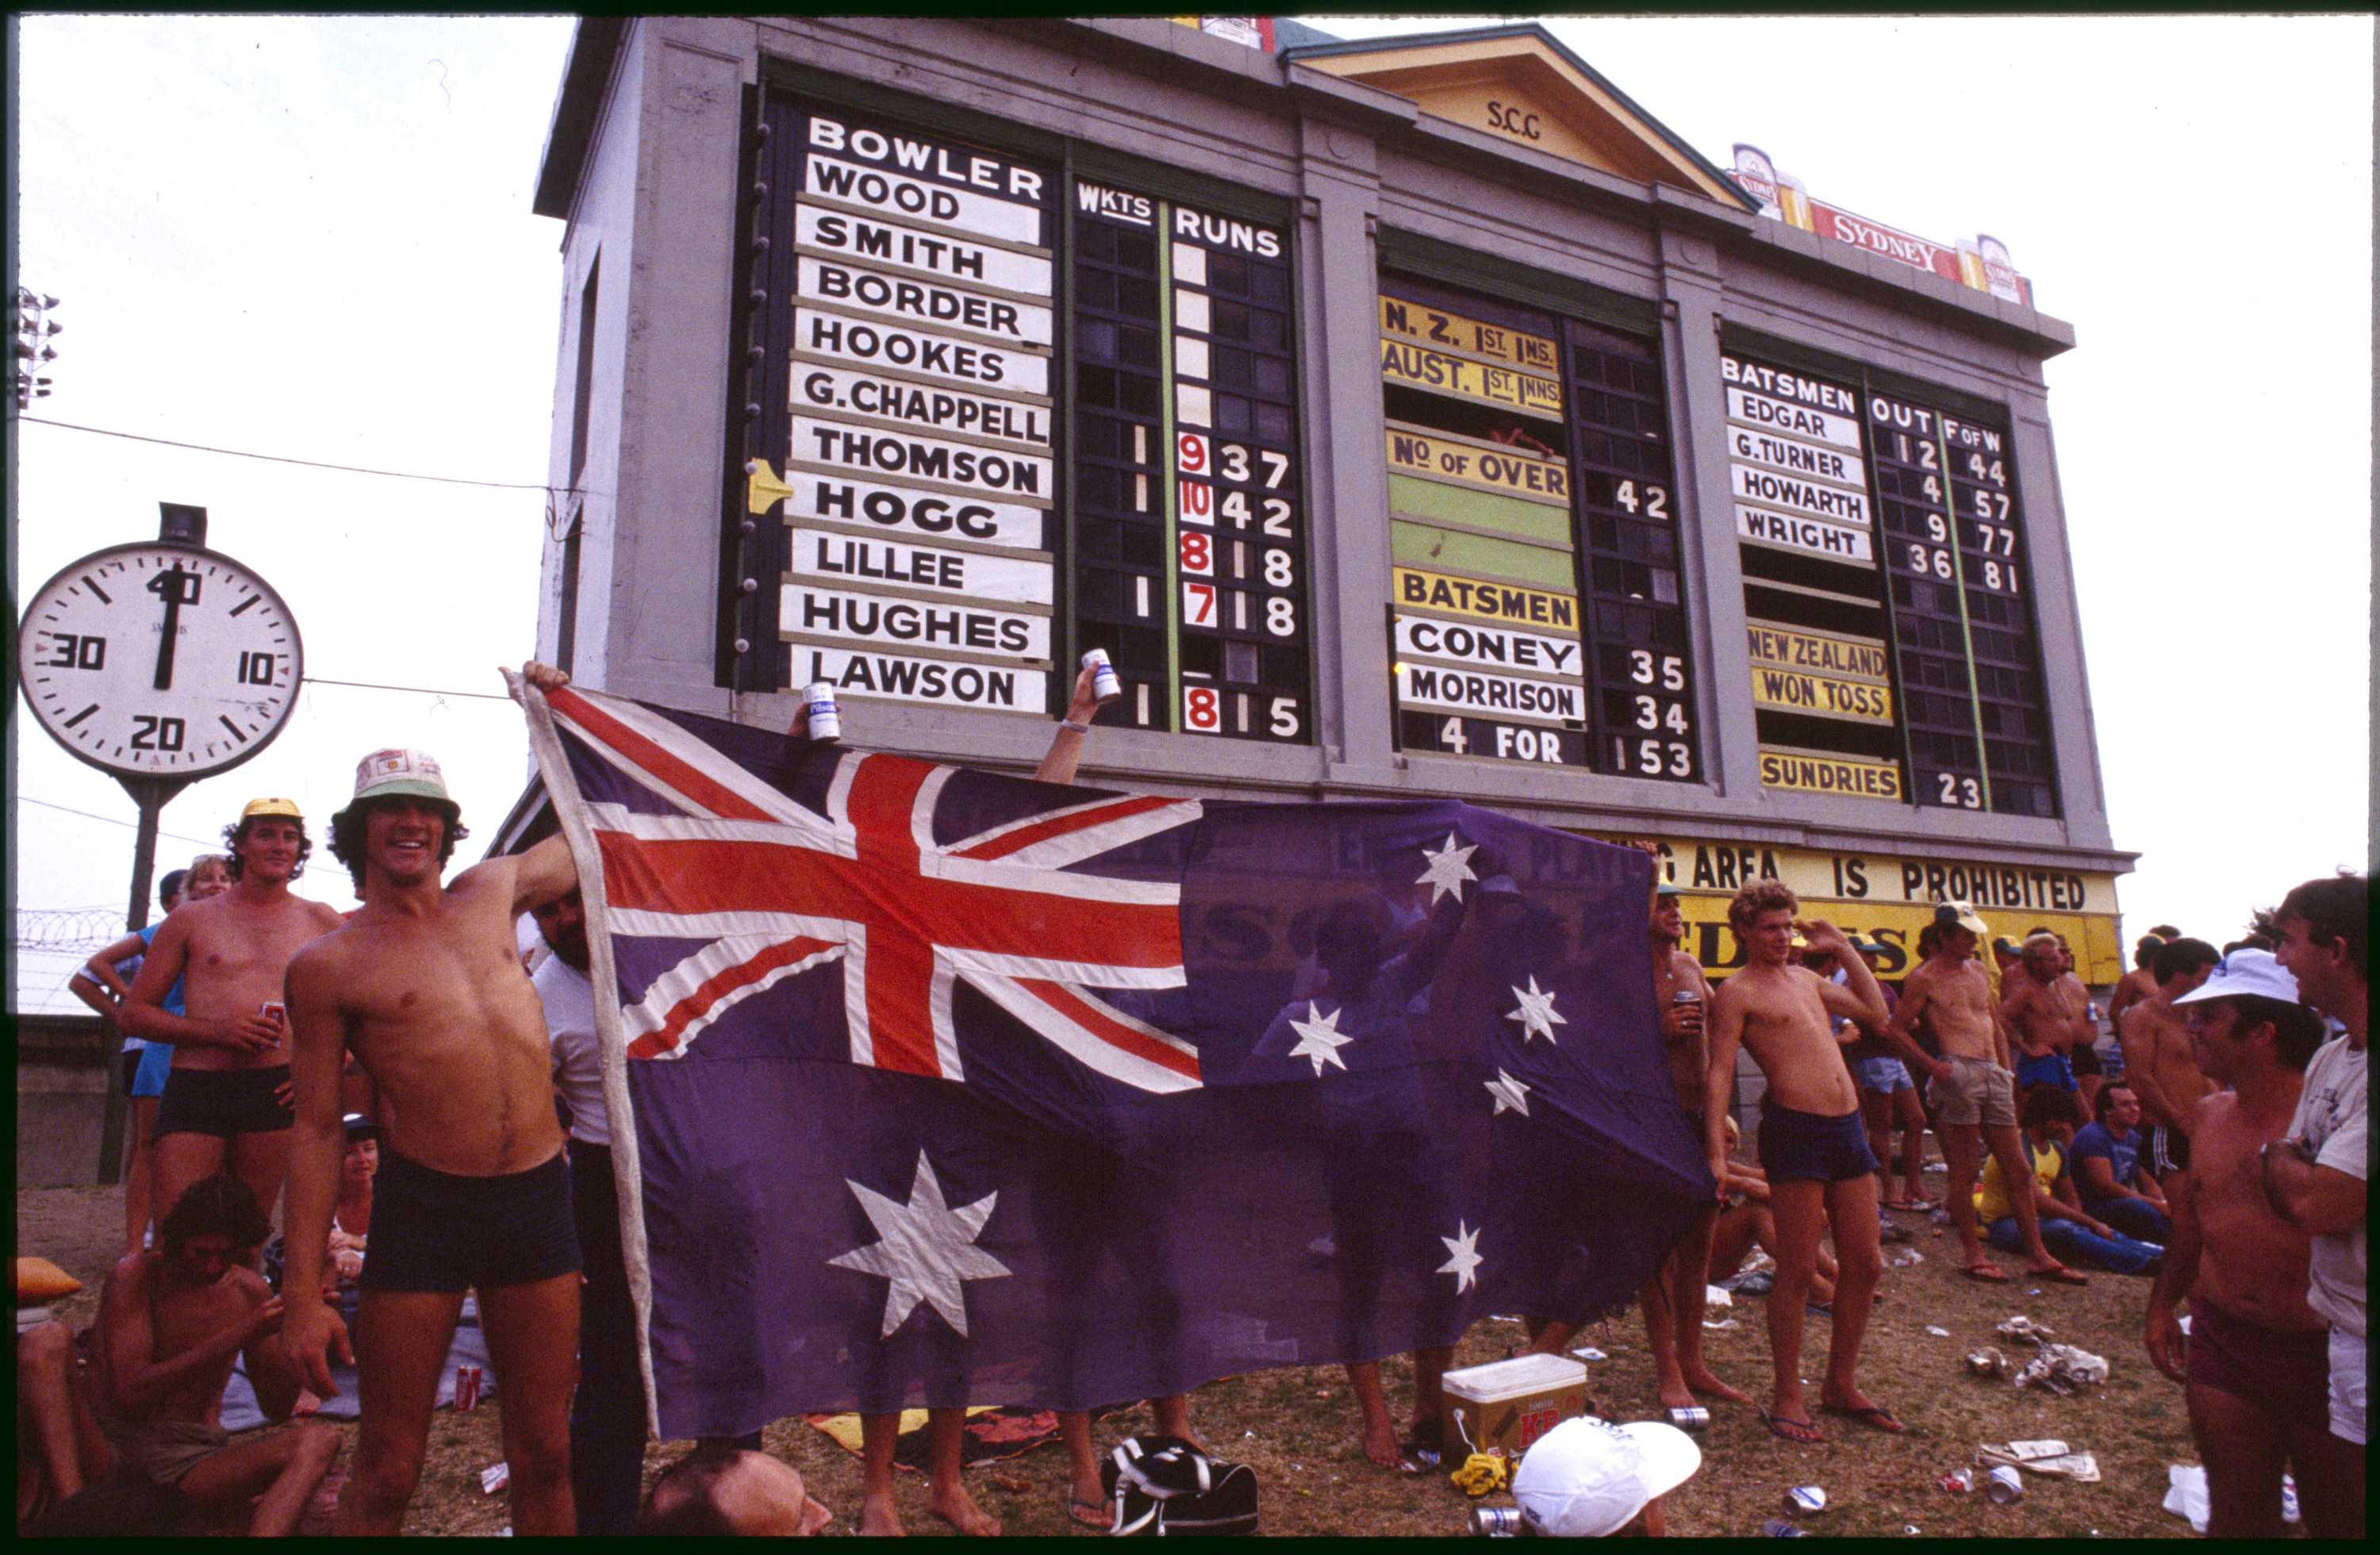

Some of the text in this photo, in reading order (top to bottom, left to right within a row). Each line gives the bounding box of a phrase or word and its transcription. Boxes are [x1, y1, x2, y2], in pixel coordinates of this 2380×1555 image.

[808, 117, 1042, 200] BOWLER
[814, 161, 960, 221] WOOD
[1078, 182, 1151, 218] WKTS
[815, 217, 984, 280] SMITH
[1176, 207, 1280, 258] RUNS
[1833, 215, 1937, 273] SYDNEY
[818, 266, 1019, 335] BORDER
[1386, 301, 1416, 336] N.
[1429, 314, 1460, 346] Z.
[812, 317, 1004, 382] HOOKES
[1384, 344, 1470, 392] AUST.
[804, 371, 1047, 443] G.CHAPPELL
[1721, 356, 1856, 413] BATSMEN
[1743, 394, 1827, 439] EDGAR
[1872, 398, 1931, 433] OUT
[1944, 419, 1959, 440] F
[1983, 429, 2001, 452] W
[812, 427, 1038, 494] THOMSON
[1180, 436, 1206, 473] 9
[1221, 444, 1289, 490] 37
[1441, 452, 1469, 474] OF
[1479, 454, 1566, 496] OVER
[1737, 433, 1845, 479] G.TURNER
[1900, 435, 2006, 488] 12 44
[816, 481, 998, 538] HOGG
[1181, 481, 1211, 516] 10
[1222, 492, 1292, 538] 42
[1617, 480, 1668, 520] 42
[1745, 471, 1863, 521] HOWARTH
[1923, 476, 2010, 520] 4 57
[1745, 512, 1856, 555] WRIGHT
[1928, 514, 2016, 554] 9 77
[816, 536, 964, 589] LILLEE
[1181, 533, 1292, 588] 8 18
[1909, 543, 2019, 593] 36 81
[146, 570, 202, 606] 40
[1187, 587, 1215, 624] 7
[1235, 589, 1296, 636] 18
[1403, 573, 1572, 628] BATSMEN
[804, 593, 1030, 653] HUGHES
[1409, 623, 1576, 670] CONEY
[49, 633, 106, 671] 30
[239, 651, 274, 686] 10
[1630, 649, 1685, 692] 35
[1748, 628, 1887, 678] NEW ZEALAND
[812, 651, 1015, 706] LAWSON
[1411, 669, 1575, 716] MORRISON
[1762, 671, 1886, 716] WON TOSS
[130, 715, 186, 752] 20
[1188, 689, 1218, 728] 8
[1238, 693, 1299, 737] 15
[1635, 695, 1688, 735] 34
[1441, 716, 1564, 764] 4 FOR
[1615, 735, 1691, 778] 153
[1761, 757, 1898, 796] SUNDRIES
[1938, 773, 1981, 809] 23
[1693, 845, 1779, 889] AREA
[1833, 856, 1869, 898] IS
[1903, 862, 2086, 912] PROHIBITED
